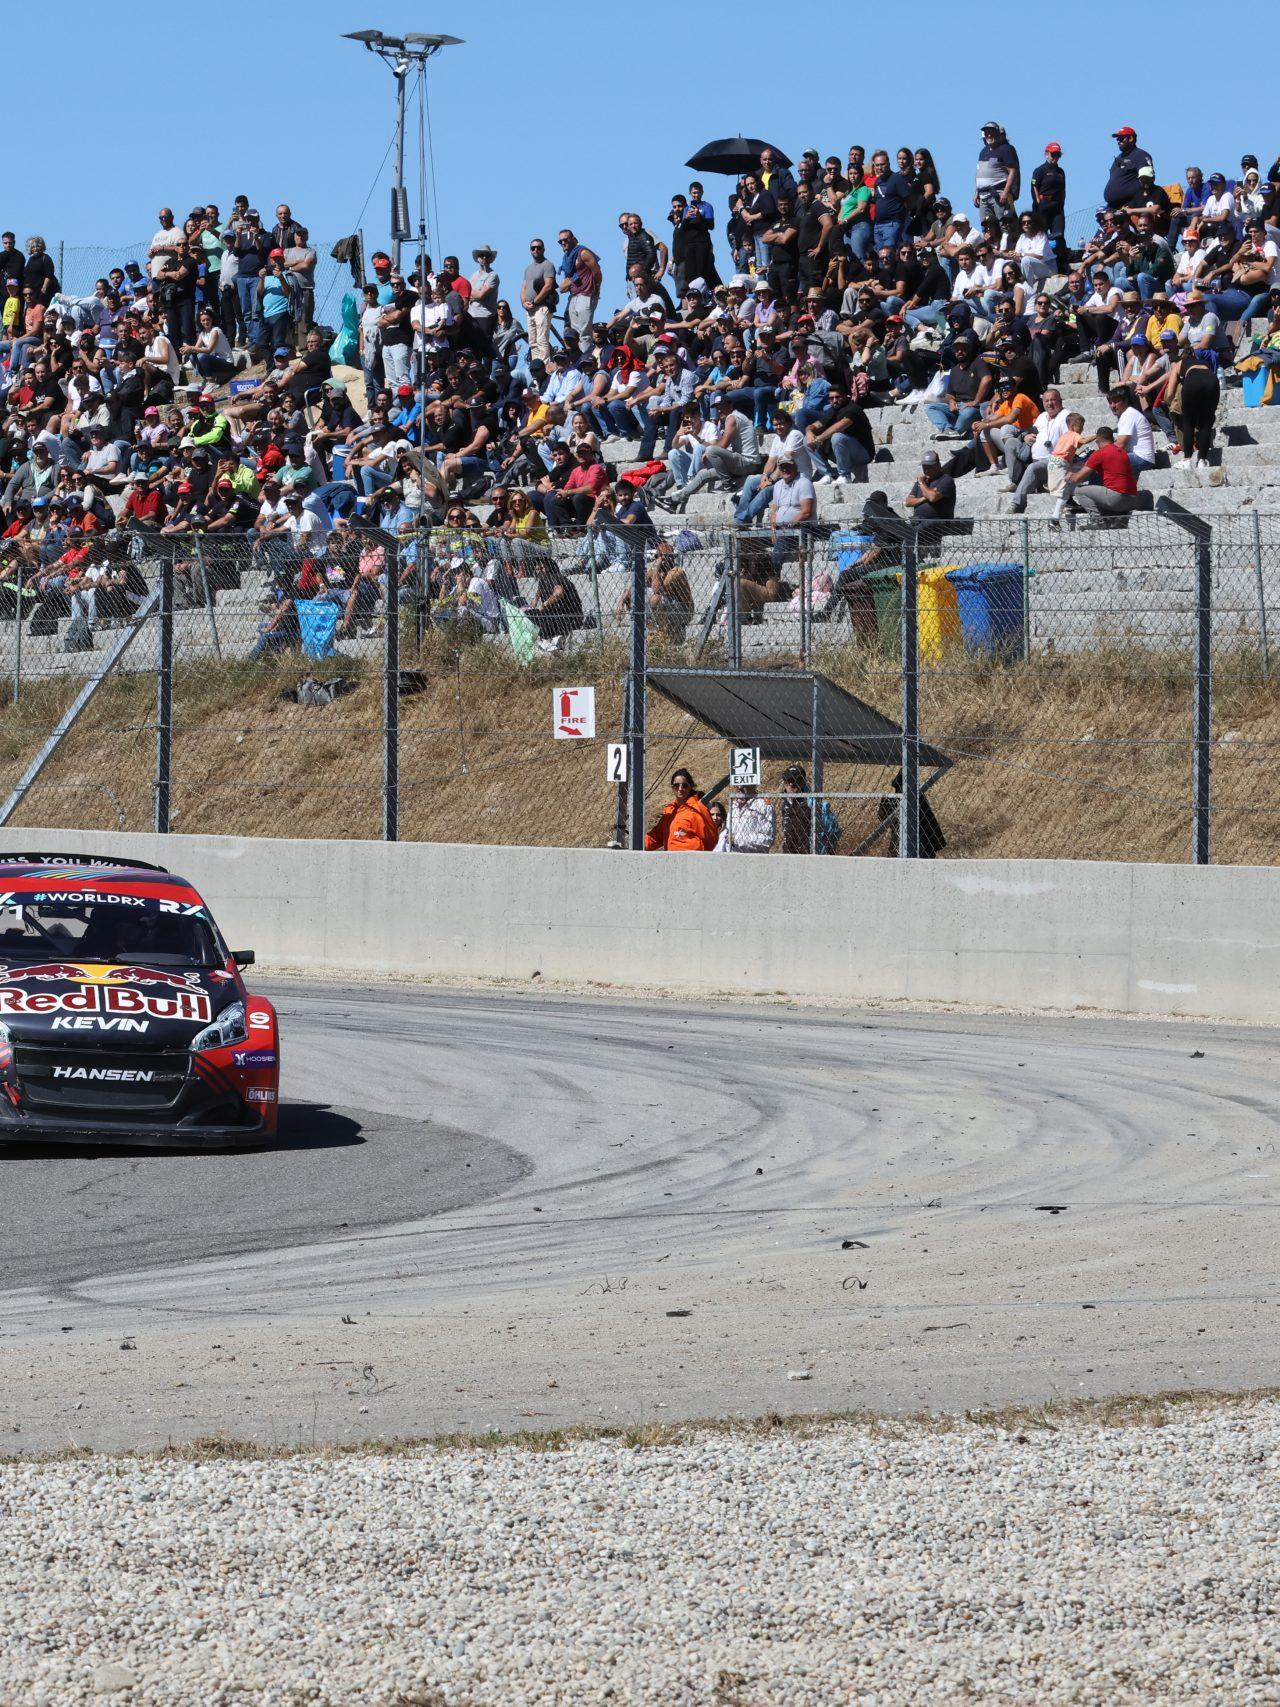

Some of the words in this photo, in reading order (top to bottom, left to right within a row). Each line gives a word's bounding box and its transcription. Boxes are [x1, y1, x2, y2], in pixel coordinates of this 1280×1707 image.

[613, 747, 622, 781] 2
[733, 775, 756, 784] EXIT
[33, 892, 147, 907] #WORLDRX
[104, 986, 212, 1023] Bull
[51, 1016, 150, 1033] KEVIN
[52, 1066, 154, 1082] HANSEN
